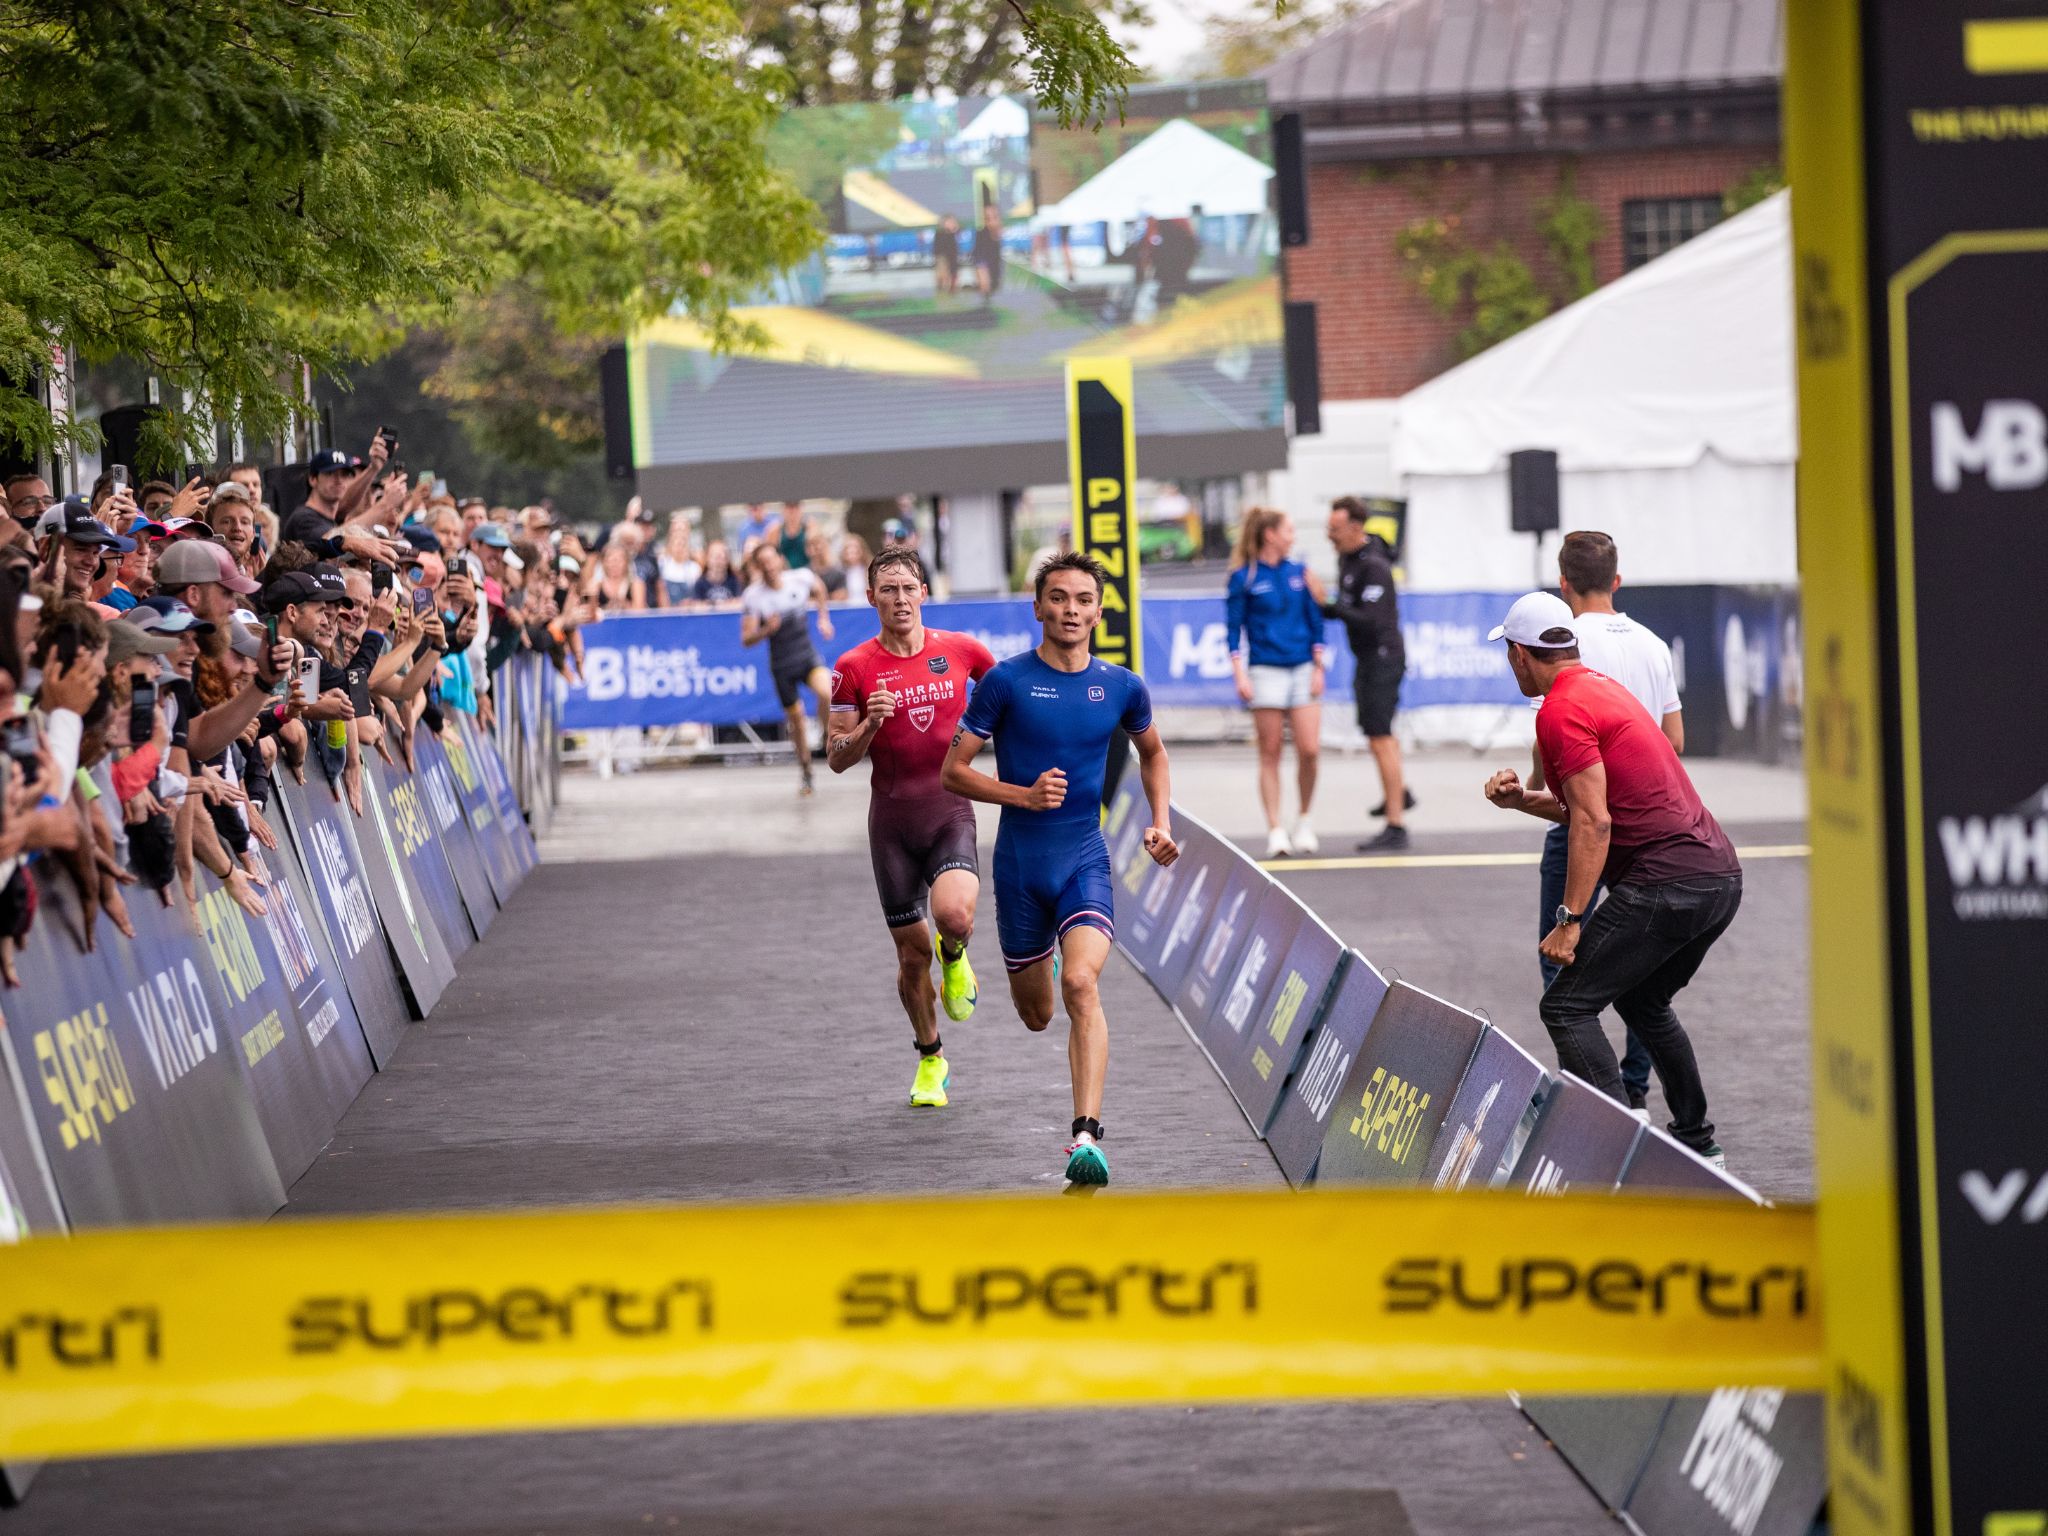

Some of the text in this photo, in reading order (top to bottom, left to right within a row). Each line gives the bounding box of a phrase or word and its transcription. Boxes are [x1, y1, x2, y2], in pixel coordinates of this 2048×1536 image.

[627, 645, 698, 670] Meet
[628, 666, 757, 699] BOSTON
[895, 680, 954, 700] AHRAIN
[897, 690, 954, 708] CTORIOUS
[196, 886, 266, 1009] FORM
[127, 957, 218, 1090] VARLO
[33, 1002, 137, 1151] supertri
[1296, 1023, 1350, 1123] VARLO
[1350, 1066, 1432, 1166] supertri
[288, 1279, 715, 1357] supertri
[837, 1259, 1259, 1328] supertri
[1381, 1256, 1808, 1320] supertri
